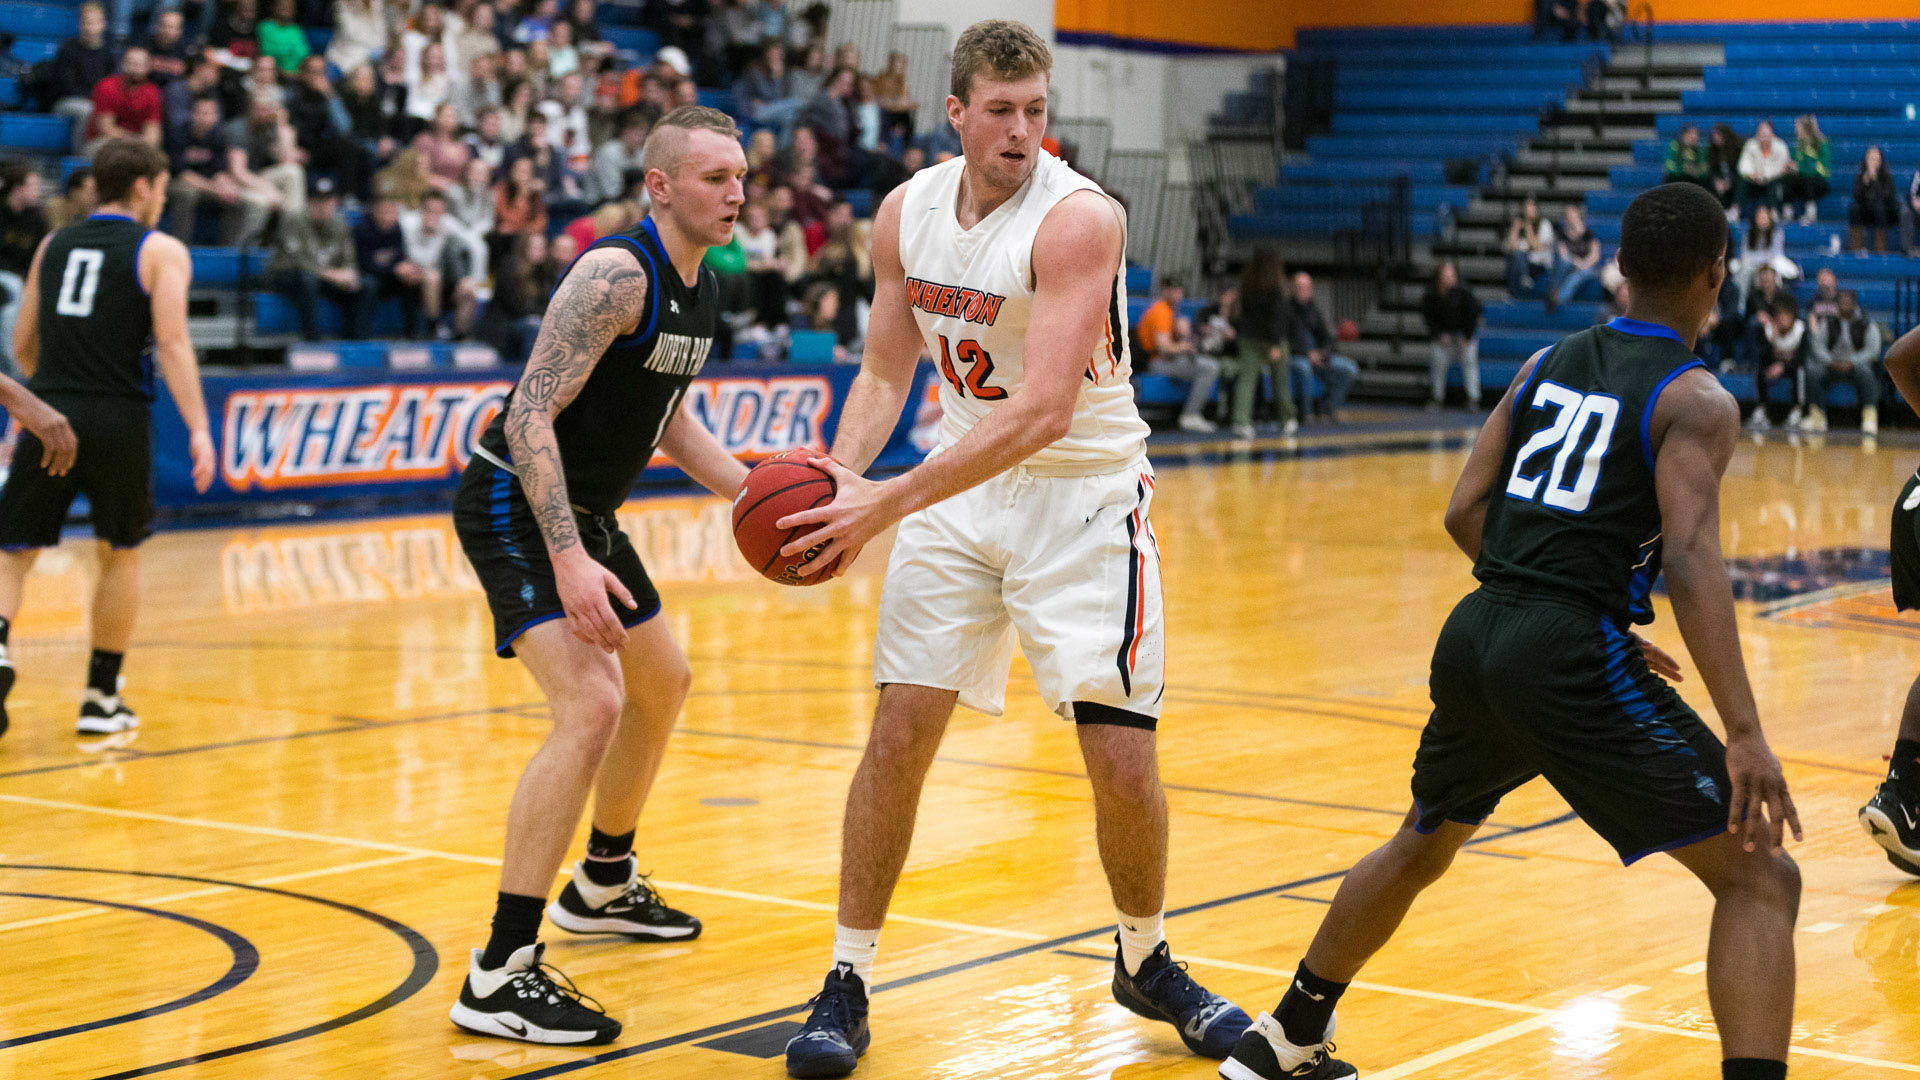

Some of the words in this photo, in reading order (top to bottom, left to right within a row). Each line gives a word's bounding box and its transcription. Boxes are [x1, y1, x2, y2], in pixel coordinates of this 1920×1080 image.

[56, 248, 105, 317] 0
[906, 277, 1006, 326] WHEATON
[642, 331, 692, 375] NORTH
[938, 334, 1009, 400] 42
[1505, 379, 1623, 515] 20
